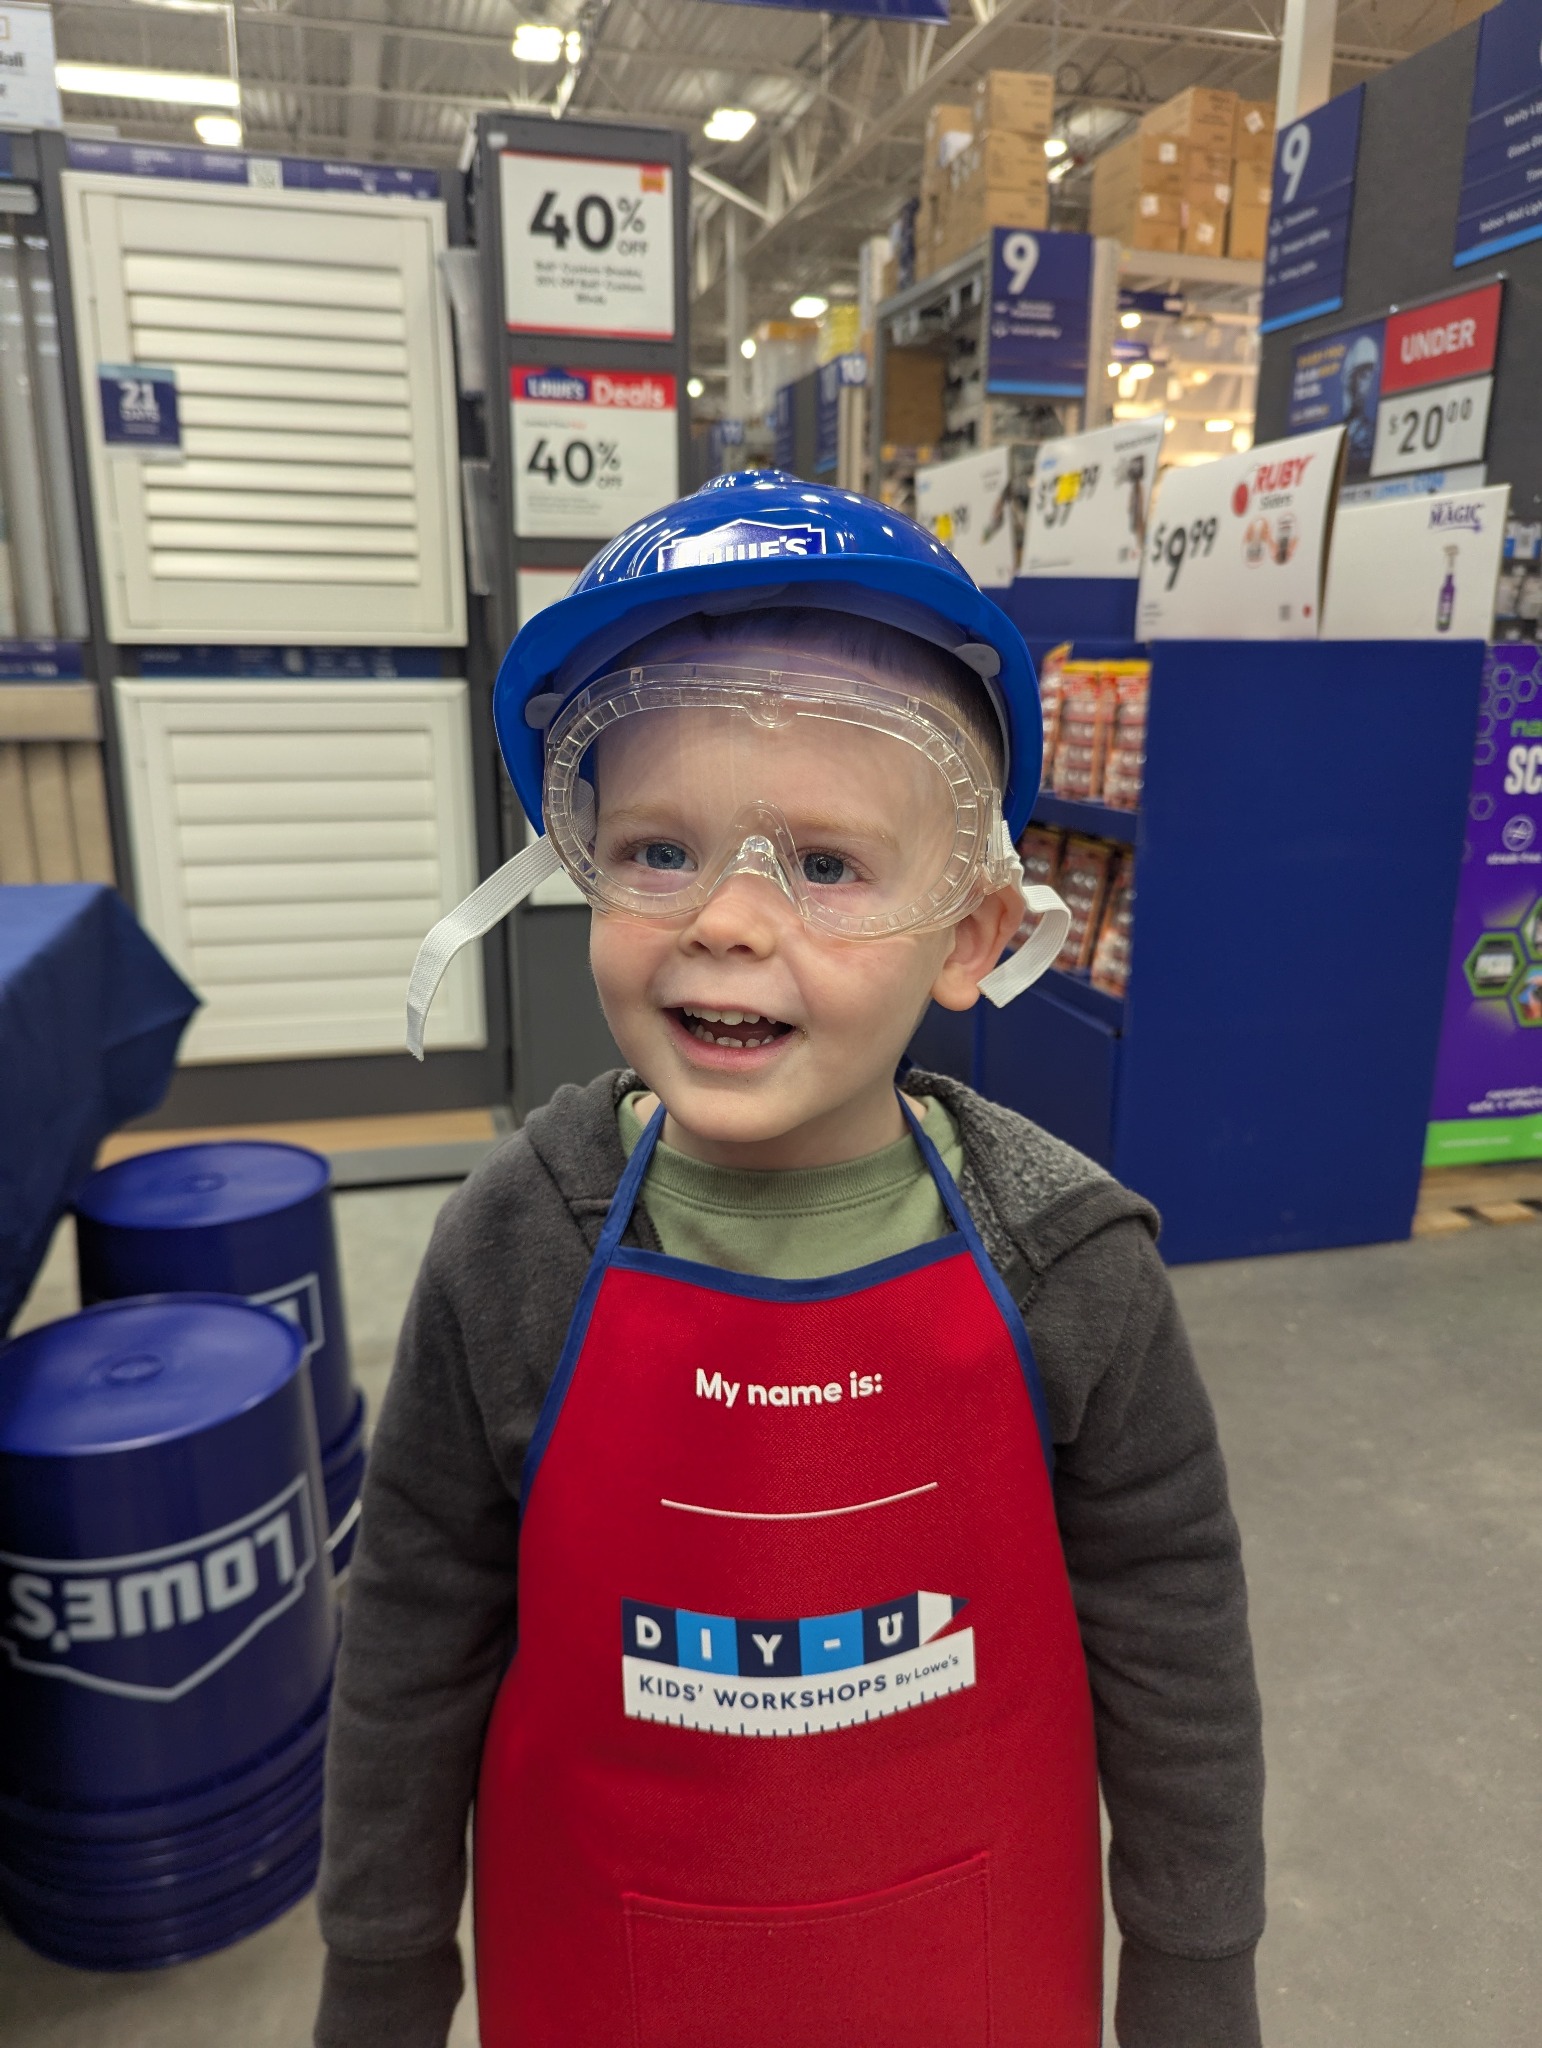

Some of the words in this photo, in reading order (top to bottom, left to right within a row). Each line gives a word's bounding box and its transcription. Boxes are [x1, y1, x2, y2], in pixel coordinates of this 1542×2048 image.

[1281, 122, 1311, 205] 9
[617, 240, 648, 256] OFF
[1002, 233, 1040, 295] 9
[1401, 318, 1477, 364] UNDER
[527, 377, 587, 401] LOWE'S
[591, 377, 666, 408] Deals
[1253, 453, 1317, 495] RUBY
[1430, 502, 1484, 528] MAGIC
[696, 1368, 740, 1408] My
[747, 1380, 843, 1408] name
[850, 1370, 883, 1400] is:
[9, 1510, 297, 1652] LOWE'S
[639, 1673, 703, 1703] KIDS'
[714, 1674, 887, 1711] WORKSHOPS
[895, 1671, 911, 1686] By
[914, 1653, 960, 1680] Lowe's
